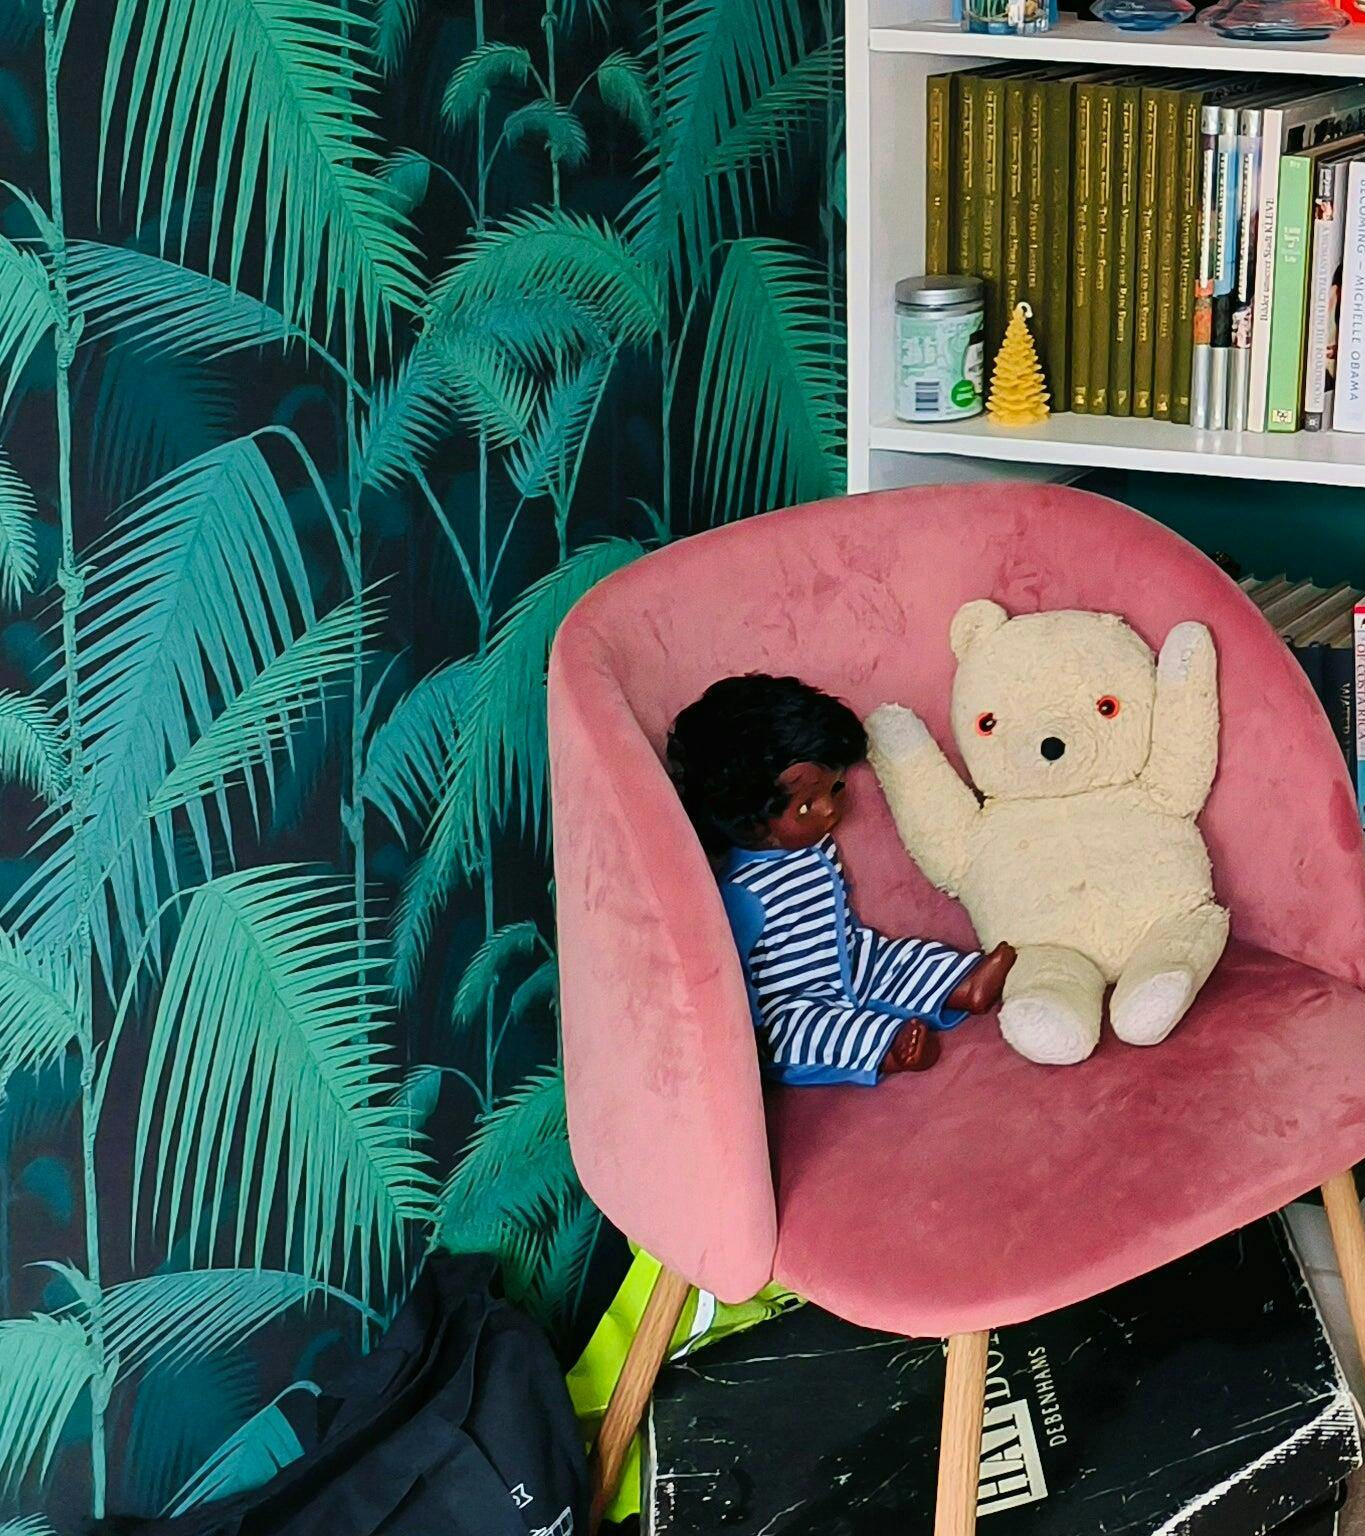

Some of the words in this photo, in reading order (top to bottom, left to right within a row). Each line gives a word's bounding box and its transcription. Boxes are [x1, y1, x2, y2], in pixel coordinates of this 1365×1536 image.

[1351, 274, 1365, 343] MICHELLE
[1349, 351, 1361, 402] OBAMA
[1027, 1345, 1068, 1448] DEBENHAMS
